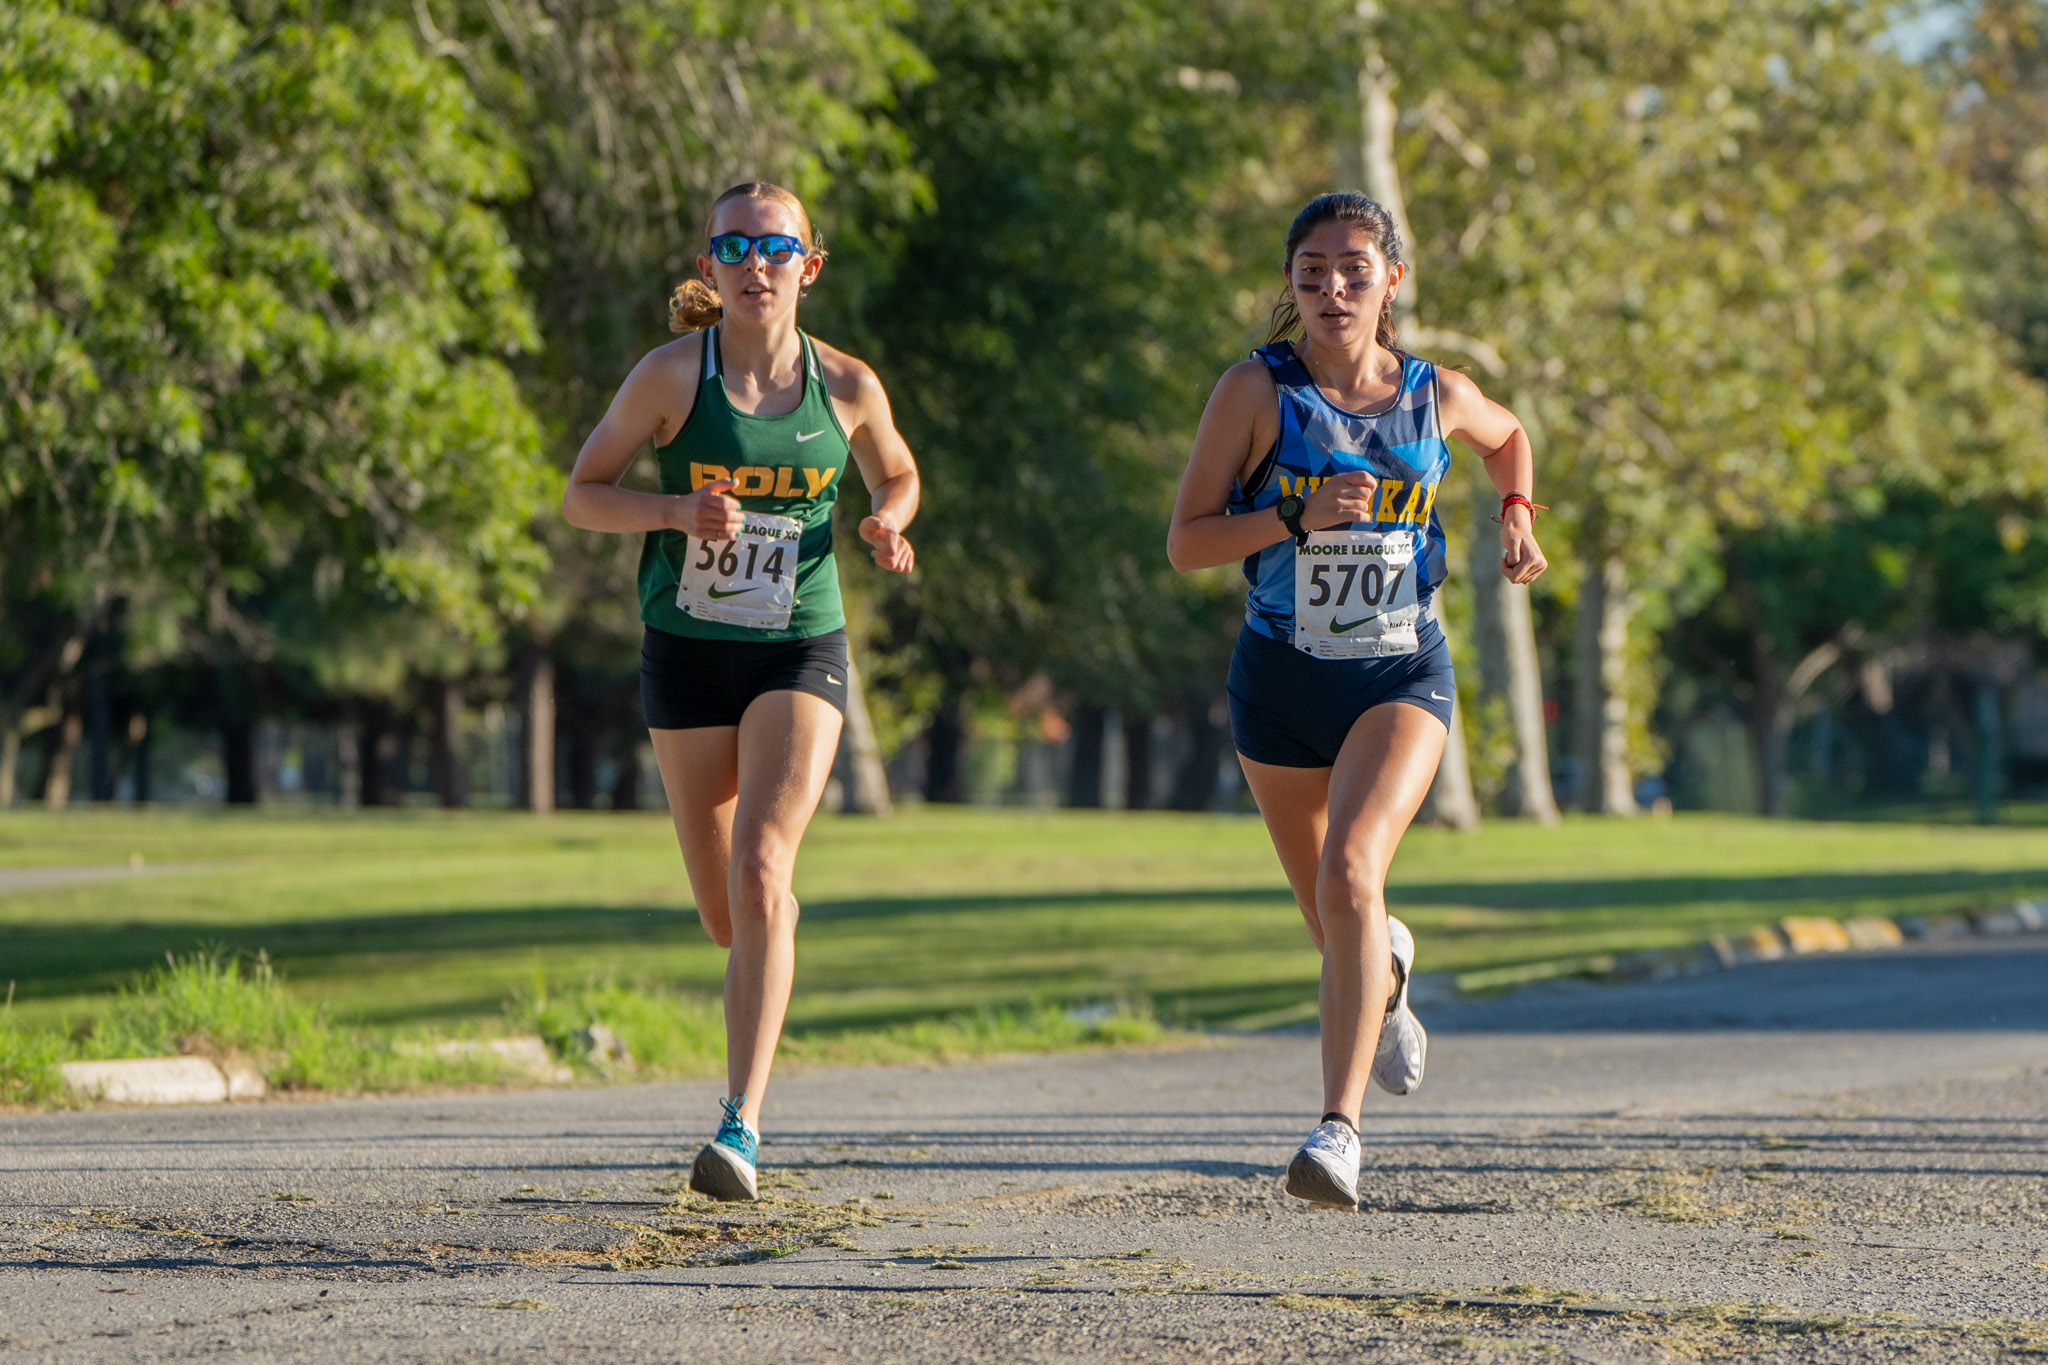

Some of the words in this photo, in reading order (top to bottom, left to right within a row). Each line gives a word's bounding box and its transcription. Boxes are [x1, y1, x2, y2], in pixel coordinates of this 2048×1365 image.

[690, 462, 837, 498] POLY
[741, 524, 782, 539] EAGUE
[784, 530, 799, 541] XC
[1299, 544, 1348, 556] MOORE
[1352, 544, 1395, 556] LEAGUE
[1398, 543, 1410, 555] XC
[695, 539, 785, 584] 5614
[1308, 563, 1407, 607] 5707
